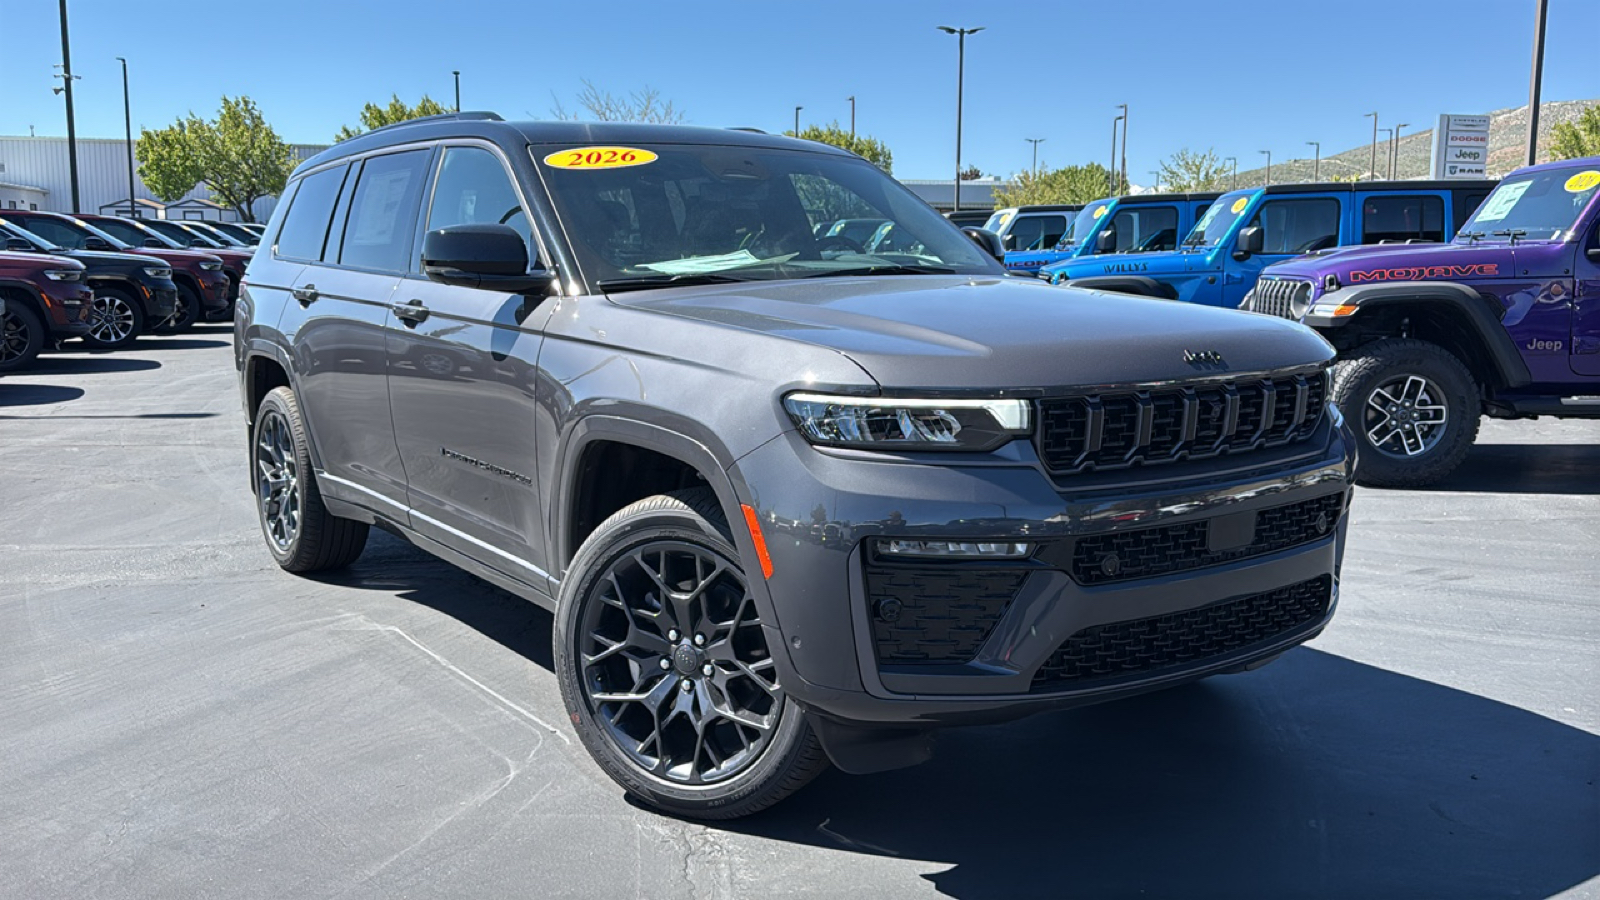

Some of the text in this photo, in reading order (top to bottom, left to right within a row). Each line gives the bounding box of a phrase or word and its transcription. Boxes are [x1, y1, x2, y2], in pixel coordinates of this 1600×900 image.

[568, 150, 636, 166] 2026
[1455, 149, 1480, 161] Jeep
[1103, 262, 1149, 274] WILLYS
[1350, 263, 1499, 282] MOJAVE
[1526, 338, 1563, 352] Jeep
